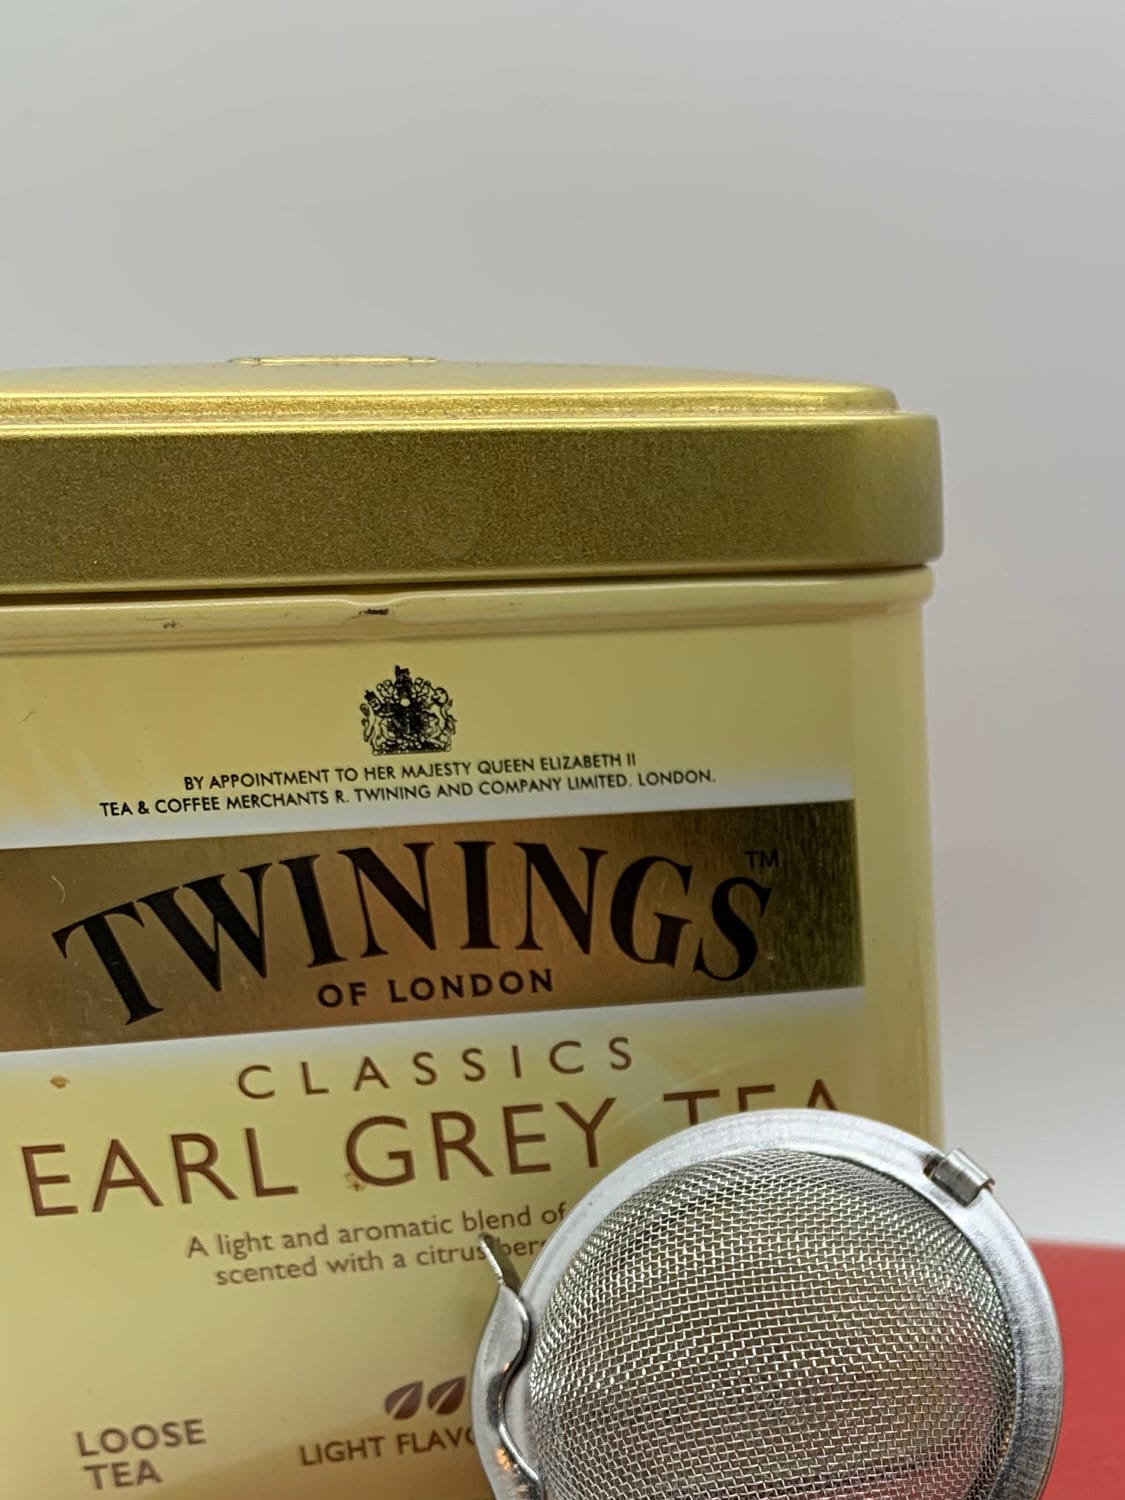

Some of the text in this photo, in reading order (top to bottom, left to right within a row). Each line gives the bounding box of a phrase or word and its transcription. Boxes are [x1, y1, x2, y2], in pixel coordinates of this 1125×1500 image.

[184, 752, 636, 790] BY APPOINTMENT TO HER MAJESTY QUEEN ELIZABETH II
[100, 801, 132, 817] TEA
[138, 800, 149, 814] &
[155, 796, 220, 814] COFFEE
[227, 790, 329, 810] MERCHANTS
[336, 790, 349, 804] R.
[354, 784, 431, 802] TWINING
[437, 780, 473, 798] AND
[479, 776, 562, 795] COMPANY
[638, 770, 716, 787] LONDON.
[51, 840, 773, 1026] TWININGS
[318, 968, 554, 1008] OF LONDON
[237, 1036, 632, 1100] CLASSICS
[21, 1127, 299, 1217] EARL
[345, 1097, 617, 1187] GREY
[187, 1201, 567, 1261] A light and aromatic blend of
[216, 1256, 317, 1286] scented
[326, 1250, 384, 1274] with
[392, 1253, 407, 1269] a
[416, 1244, 486, 1266] citrus
[76, 1418, 206, 1456] LOOSE
[300, 1435, 386, 1467] LIGHT
[84, 1459, 162, 1490] TEA
